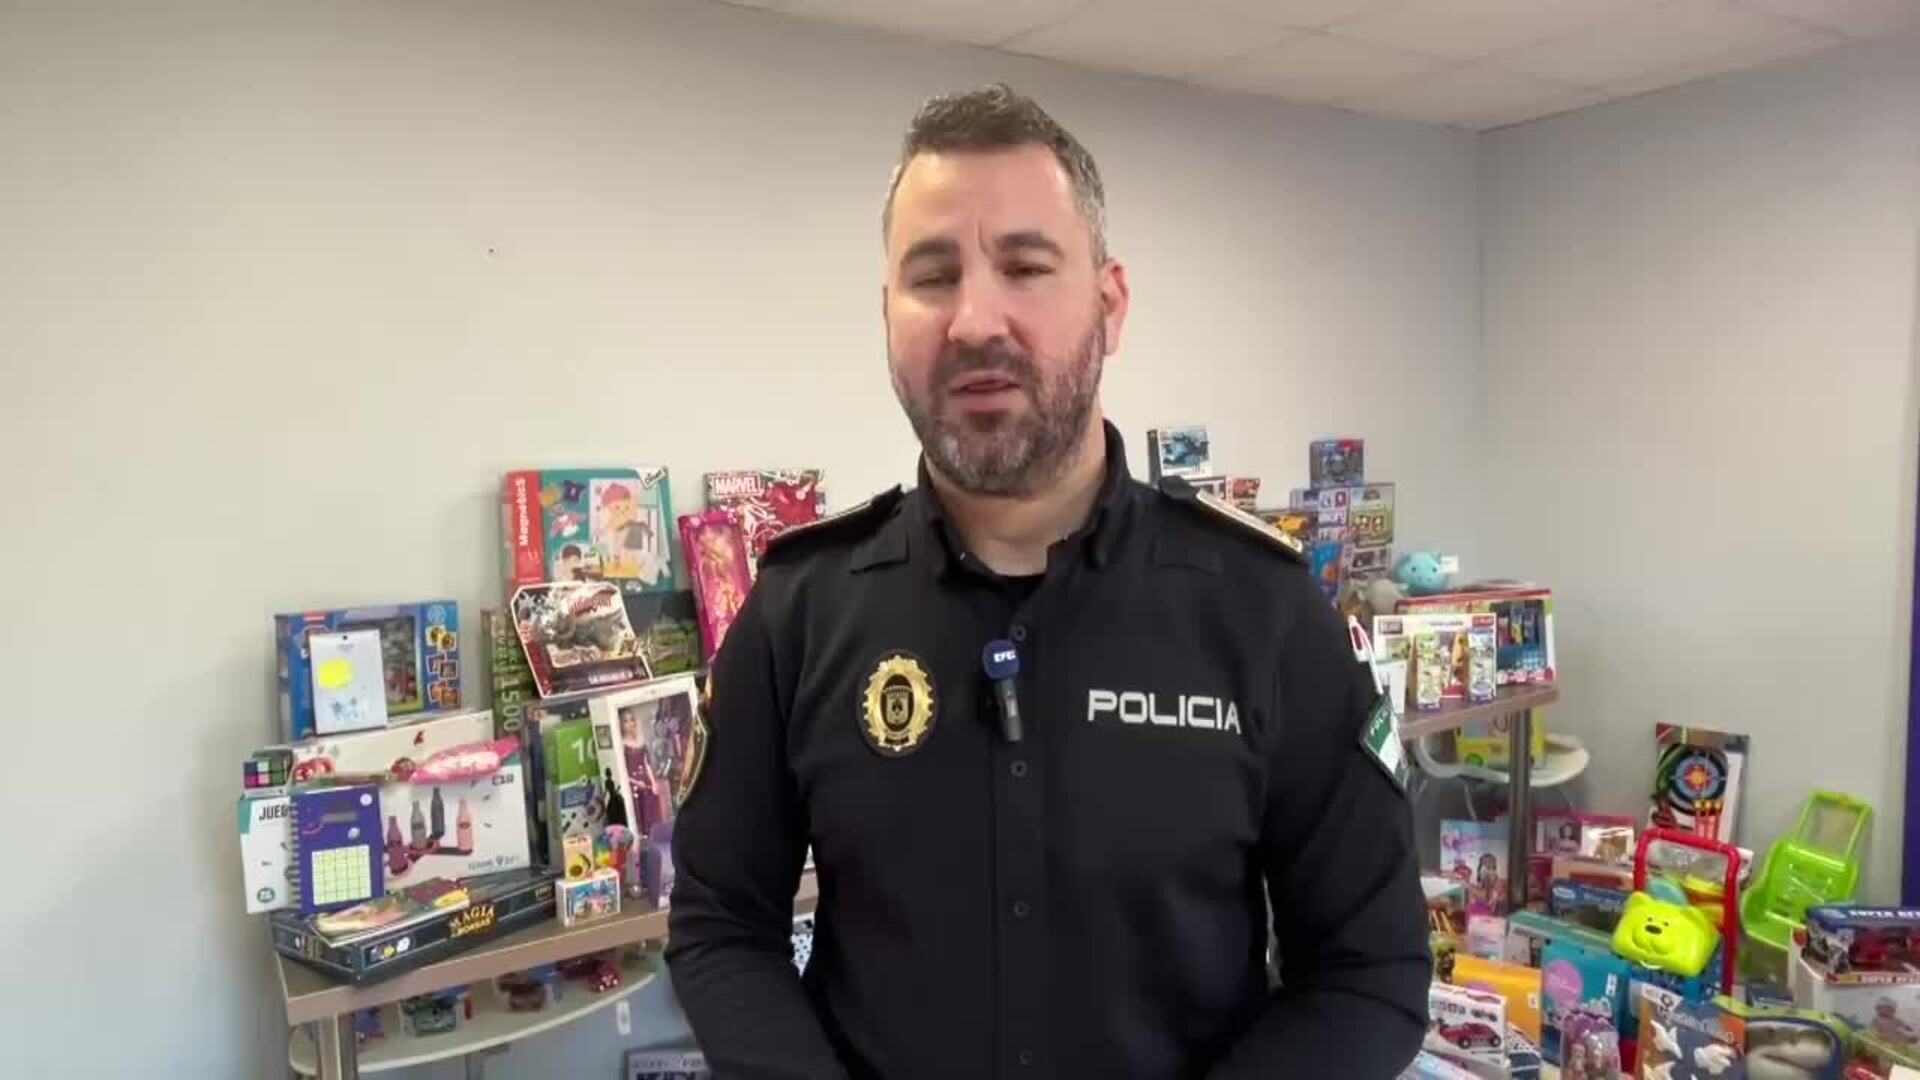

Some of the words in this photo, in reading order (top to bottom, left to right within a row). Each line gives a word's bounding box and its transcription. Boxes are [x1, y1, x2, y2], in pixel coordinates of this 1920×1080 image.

[714, 475, 758, 494] MARVEL
[515, 478, 530, 547] Magnetics
[501, 677, 521, 731] 1500
[1088, 689, 1242, 735] POLICIA
[450, 904, 495, 929] MAGIA
